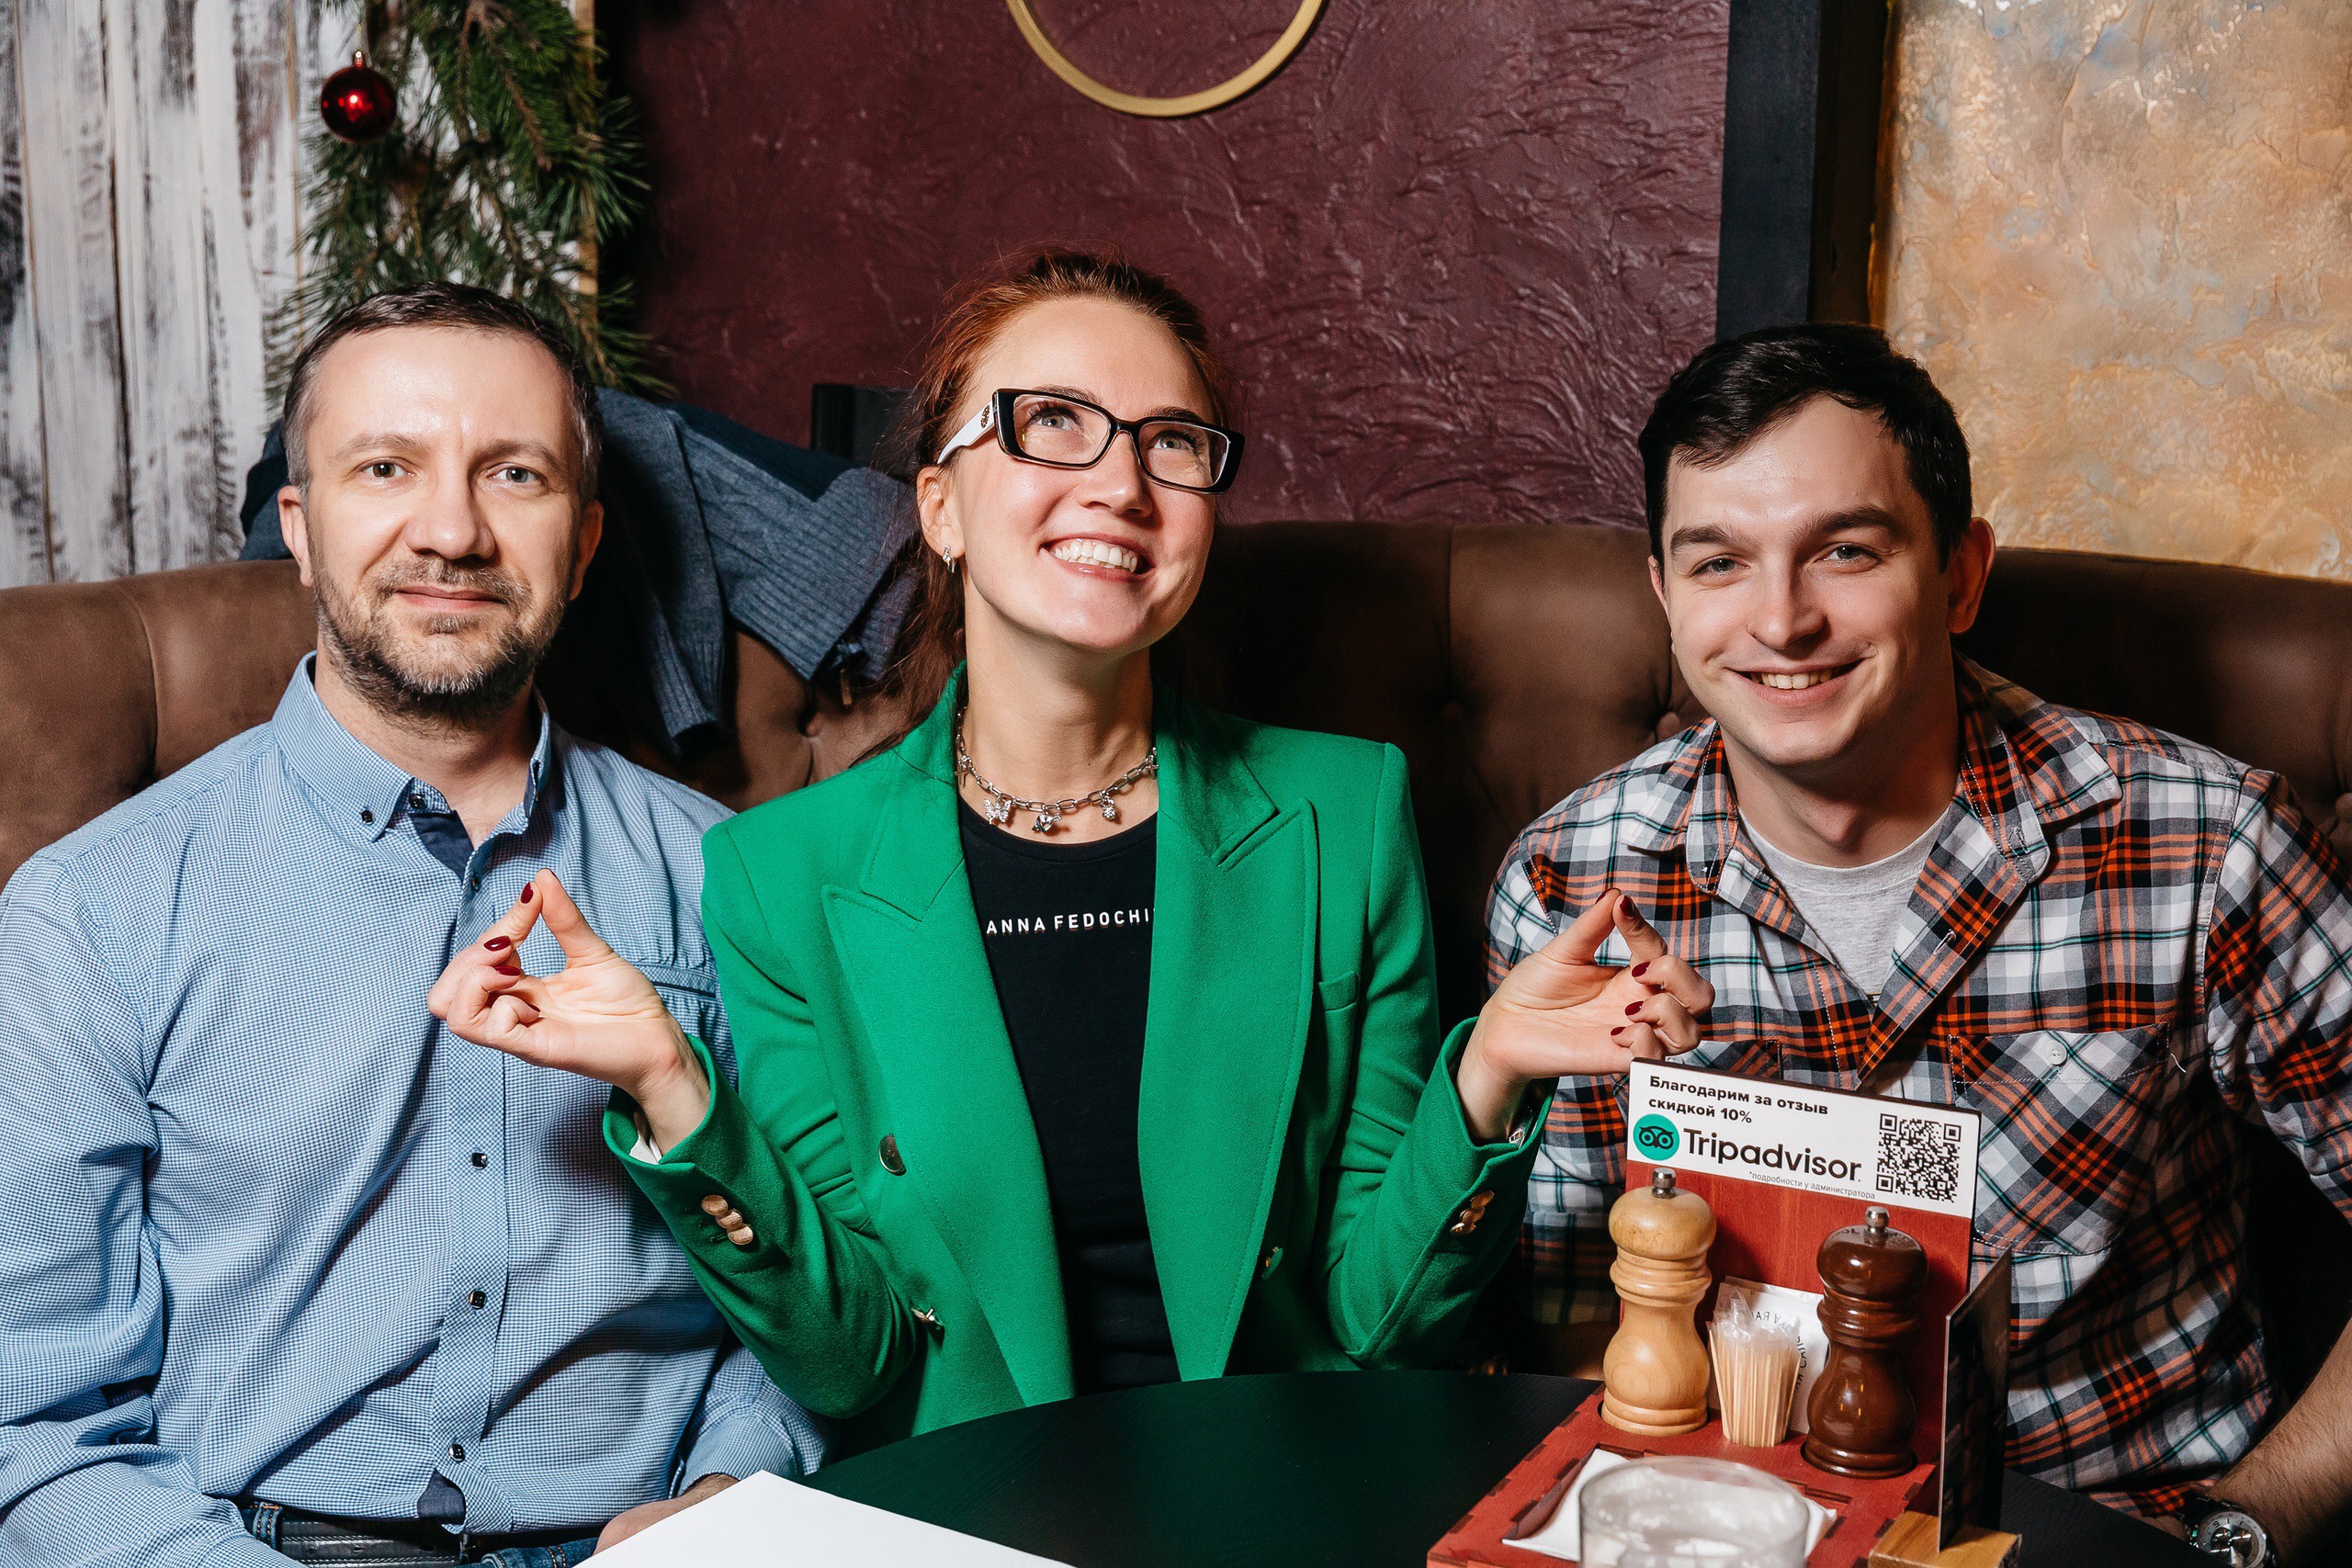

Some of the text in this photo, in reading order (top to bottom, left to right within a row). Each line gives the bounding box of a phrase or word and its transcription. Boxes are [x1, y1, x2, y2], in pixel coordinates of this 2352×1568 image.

[986, 908, 1155, 935] ANNA FEDOCHI
[1649, 1075, 1828, 1115] Благодарим за отзыв
[1648, 1098, 1752, 1123] скидкой 10%
[1683, 1127, 1862, 1182] Tripadvisor
[1804, 1181, 1809, 1190] у
[1811, 1181, 1875, 1200] администратора
